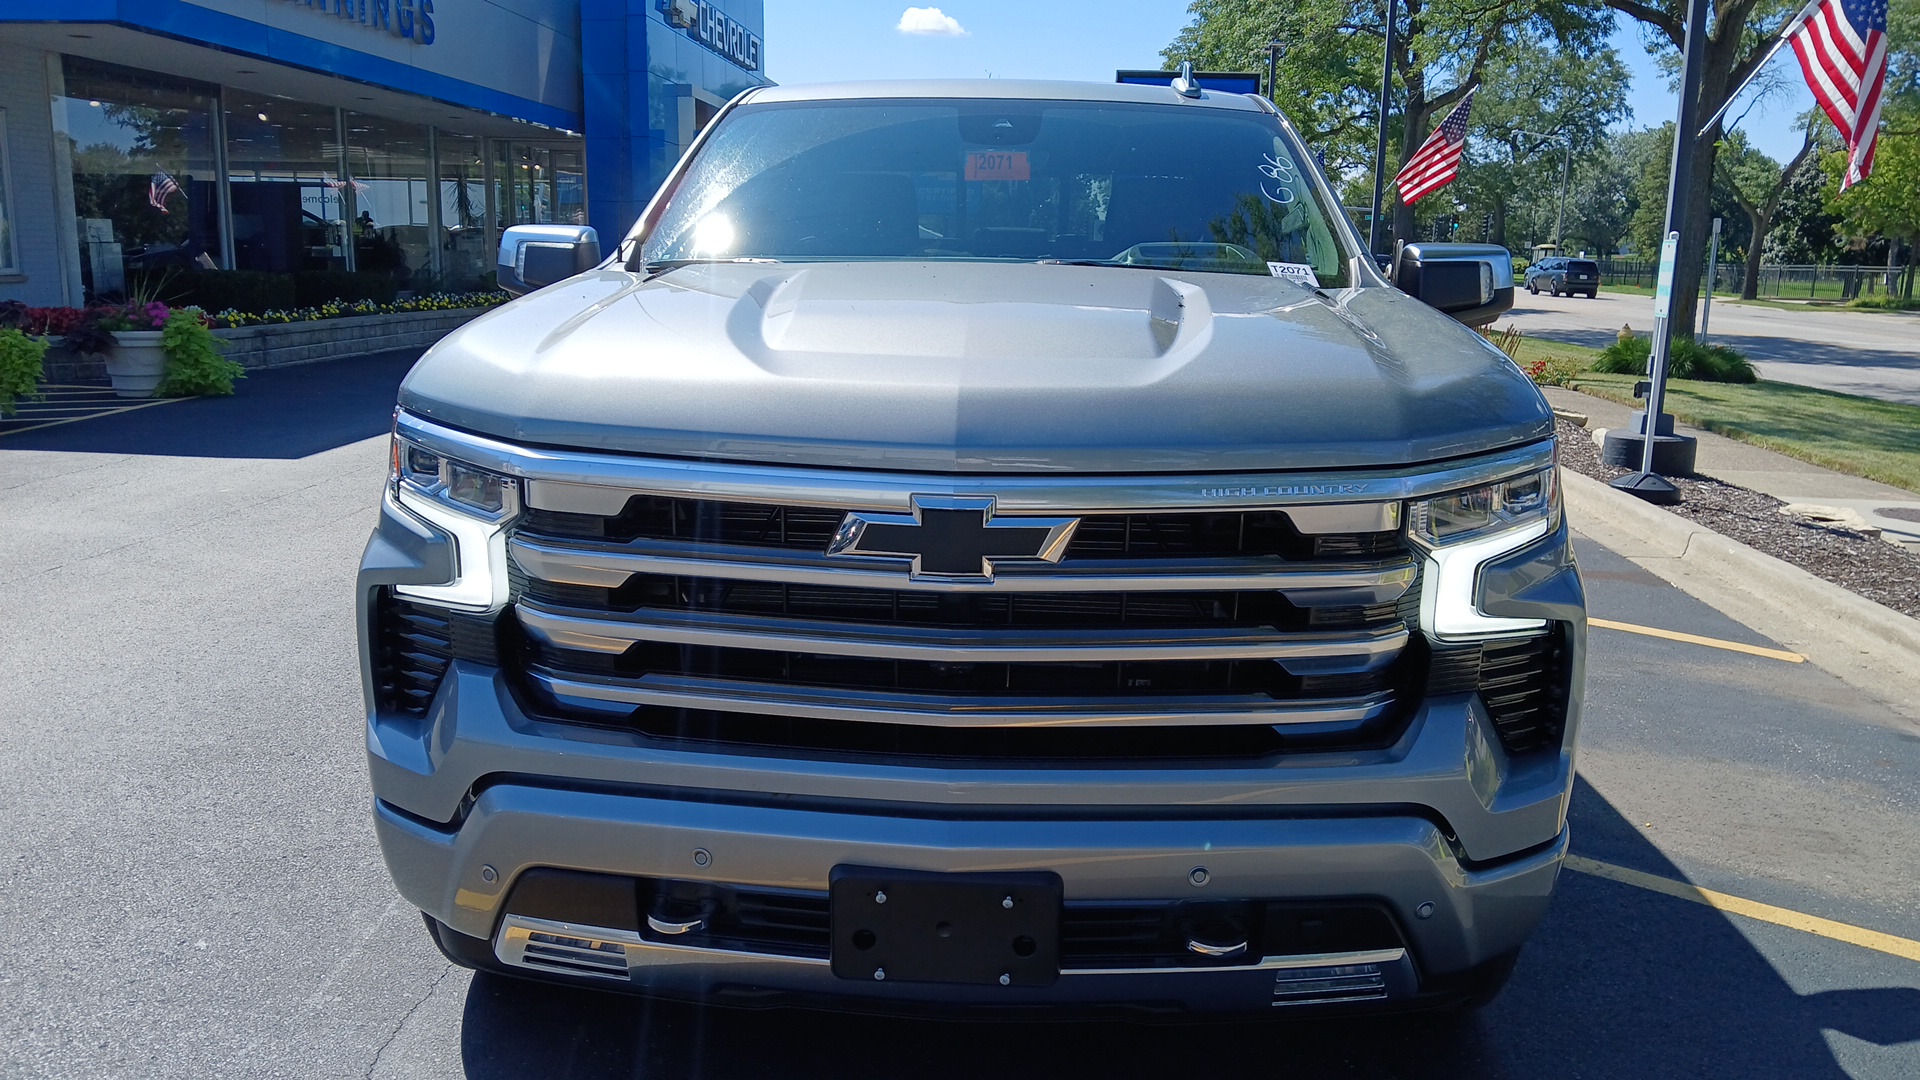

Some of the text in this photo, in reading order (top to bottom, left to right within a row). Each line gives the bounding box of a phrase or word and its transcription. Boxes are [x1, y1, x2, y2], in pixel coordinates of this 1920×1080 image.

[699, 1, 761, 69] CHEVROLET
[978, 155, 1012, 170] 2071
[1257, 152, 1294, 203] 686
[1270, 265, 1310, 275] T2071
[1201, 483, 1369, 498] HIGH COUNTRY
